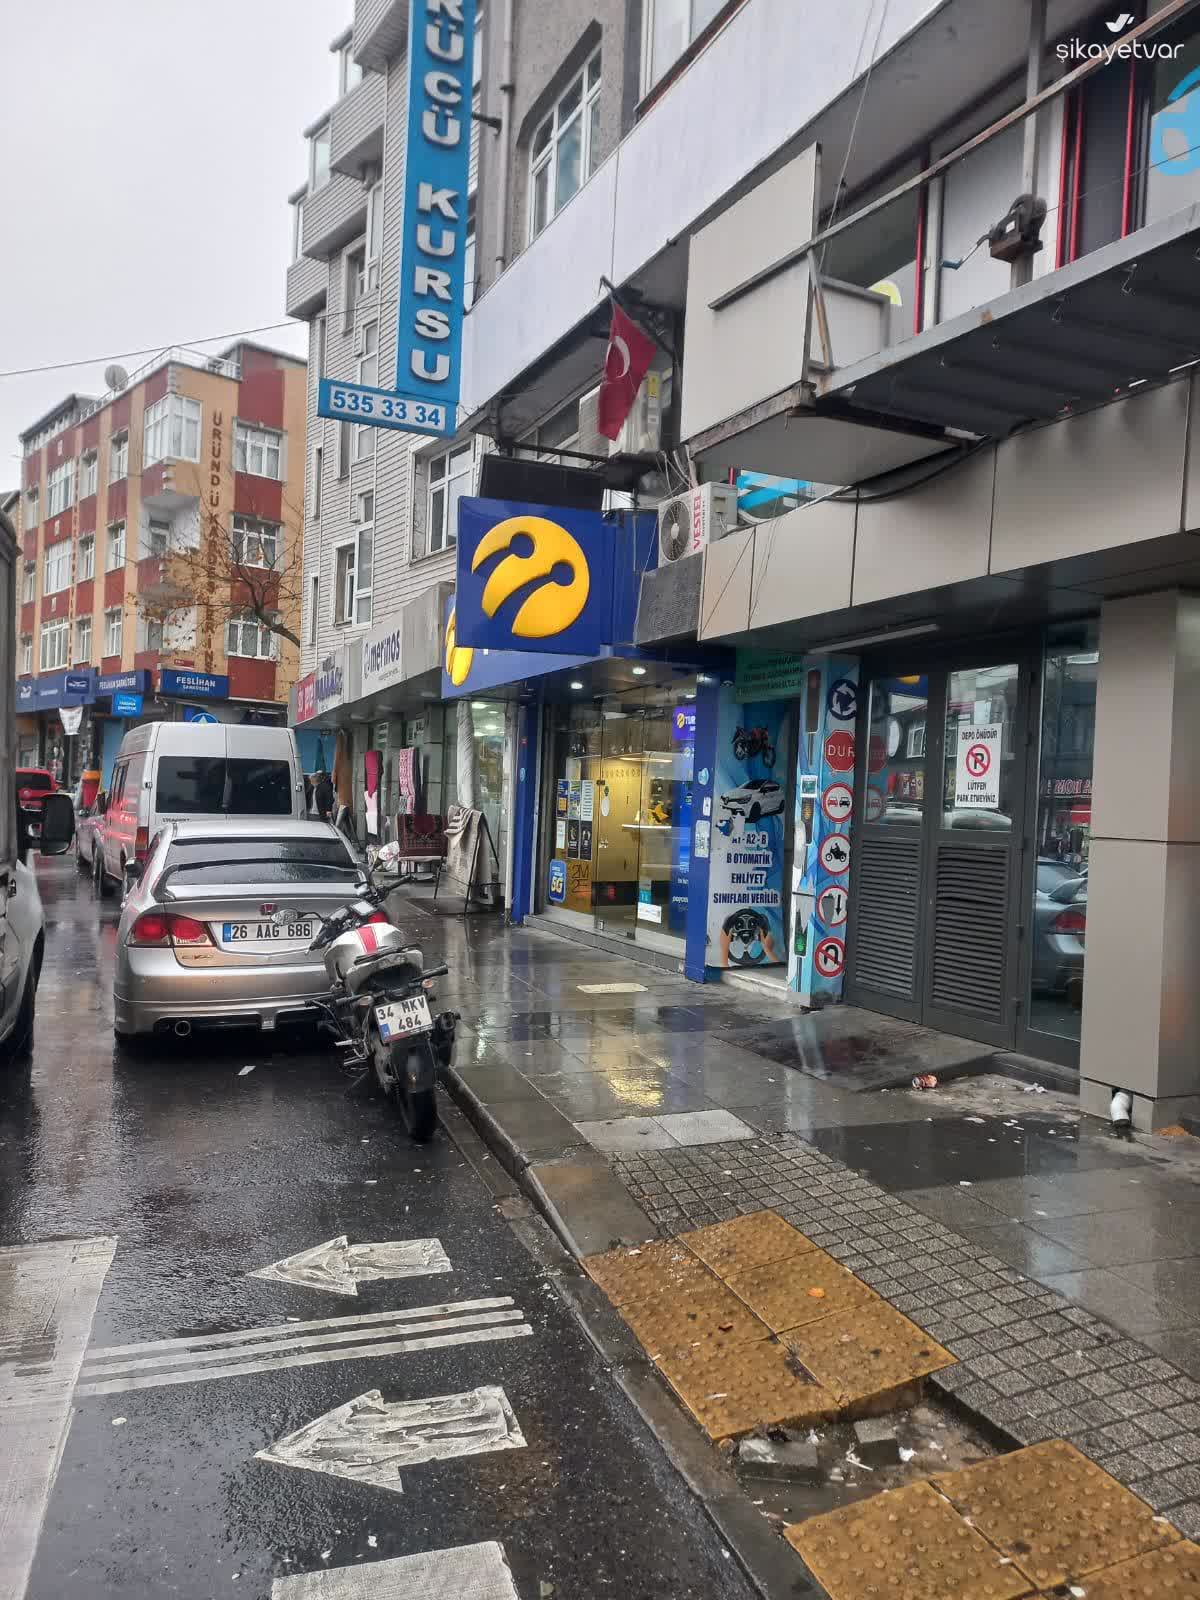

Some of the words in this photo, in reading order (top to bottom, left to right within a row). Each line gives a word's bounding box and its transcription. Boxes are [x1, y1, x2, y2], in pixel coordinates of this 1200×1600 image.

[411, 182, 459, 382] KURSU
[333, 390, 374, 414] 535
[381, 399, 408, 420] 33
[414, 405, 441, 426] 34
[176, 676, 216, 688] FESLİHAN
[961, 731, 975, 740] DEPO
[726, 852, 732, 864] B
[733, 851, 771, 865] OTOMATİK
[731, 872, 765, 884] EHLİYET
[713, 893, 750, 904] SINIFLARI
[751, 892, 779, 904] VERİLİR
[231, 924, 248, 940] 26
[256, 924, 280, 939] AAG
[287, 923, 311, 938] 686
[377, 1006, 395, 1020] 34
[398, 1014, 422, 1030] 484
